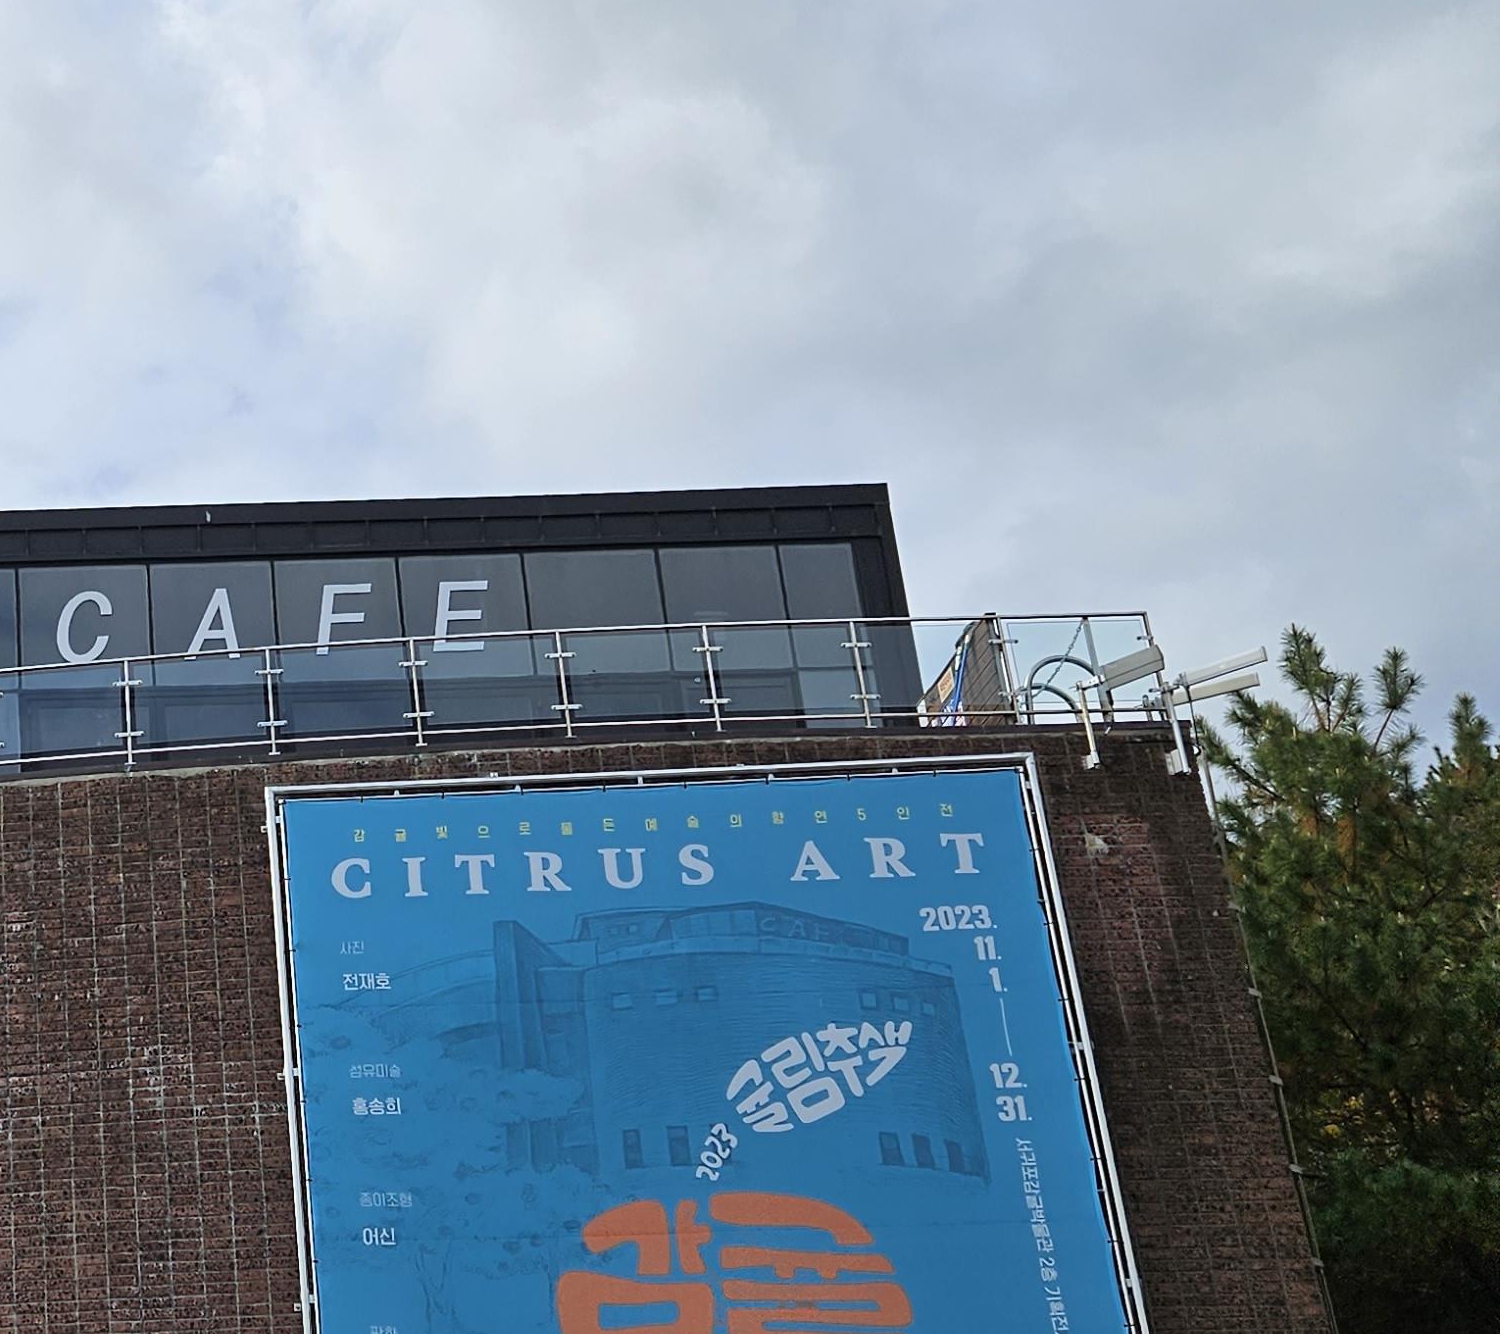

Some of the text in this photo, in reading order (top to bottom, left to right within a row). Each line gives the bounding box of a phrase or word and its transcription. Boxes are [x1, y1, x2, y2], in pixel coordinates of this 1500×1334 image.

[56, 580, 488, 664] CAFE
[331, 833, 984, 899] CITRUS ART
[919, 905, 998, 931] 2023.
[340, 941, 364, 955] 사진
[974, 936, 1002, 960] 11.
[343, 972, 392, 991] 전재호
[989, 967, 1008, 992] 1.
[990, 1063, 1028, 1088] 12.
[352, 1097, 402, 1116] 홍송희
[996, 1095, 1033, 1122] 31.
[695, 1122, 738, 1181] 2023
[362, 1226, 397, 1246] 어신
